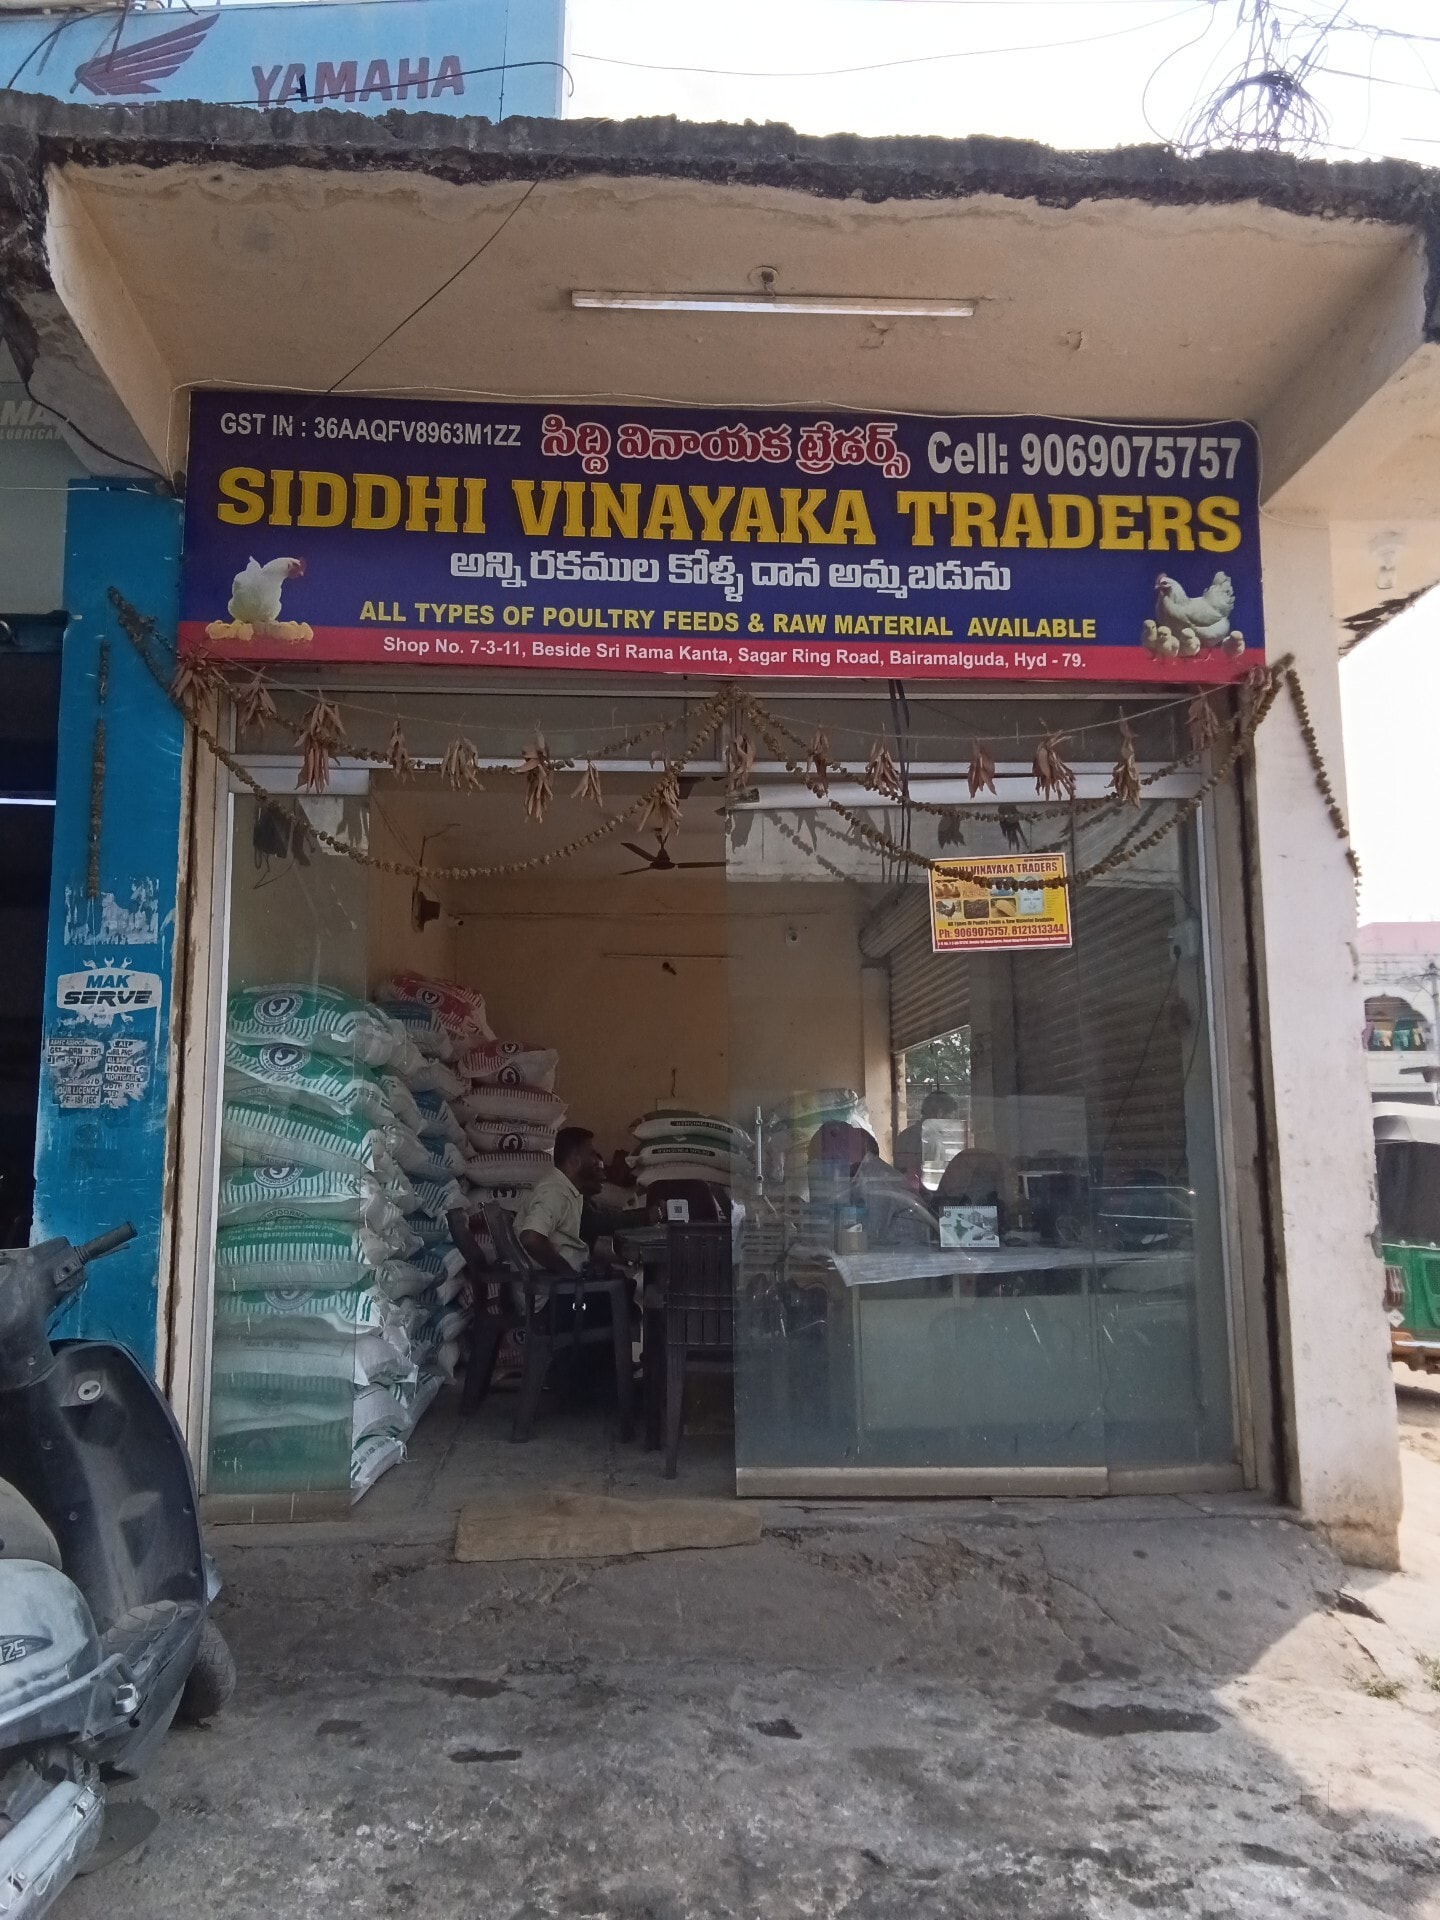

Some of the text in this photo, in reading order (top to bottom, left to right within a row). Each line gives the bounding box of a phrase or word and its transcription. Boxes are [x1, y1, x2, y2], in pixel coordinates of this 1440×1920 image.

[252, 55, 464, 107] YAMAHA
[220, 412, 266, 435] GST
[272, 414, 293, 437] IN
[314, 416, 521, 446] 36AAQFV8963M1ZZ
[618, 423, 792, 463] వినాయక
[928, 431, 1242, 480] Cell: 9069075757
[217, 466, 1242, 553] SIDDHI VINAYAKA TRADERS
[450, 551, 527, 588] అన్ని
[530, 550, 660, 583] రకముల
[751, 557, 821, 587] దాన
[359, 601, 1096, 639] ALL TYPES OF POULTRY FEEDS & RAW MATERIAL AVAILABLE
[383, 636, 430, 656] Shop
[435, 638, 464, 655] No.
[469, 639, 527, 658] 7-3-11,
[532, 641, 592, 658] Beside
[596, 643, 620, 658] Sri
[625, 644, 673, 660] Rama
[679, 645, 733, 664] Kanta,
[737, 647, 787, 667] Sagar
[792, 648, 831, 667] Ring
[836, 649, 885, 668] Road,
[889, 650, 1009, 669] Bairamalguda,
[1014, 651, 1047, 671] Hyd
[1062, 653, 1086, 668] 79.
[972, 863, 1015, 876] VINAYAKA
[1017, 862, 1058, 873] TRADERS
[938, 928, 953, 939] Ph:
[1011, 923, 1065, 936] 8121313344
[63, 990, 153, 1007] SERVE
[86, 975, 130, 989] MAK
[107, 1064, 132, 1073] HOME
